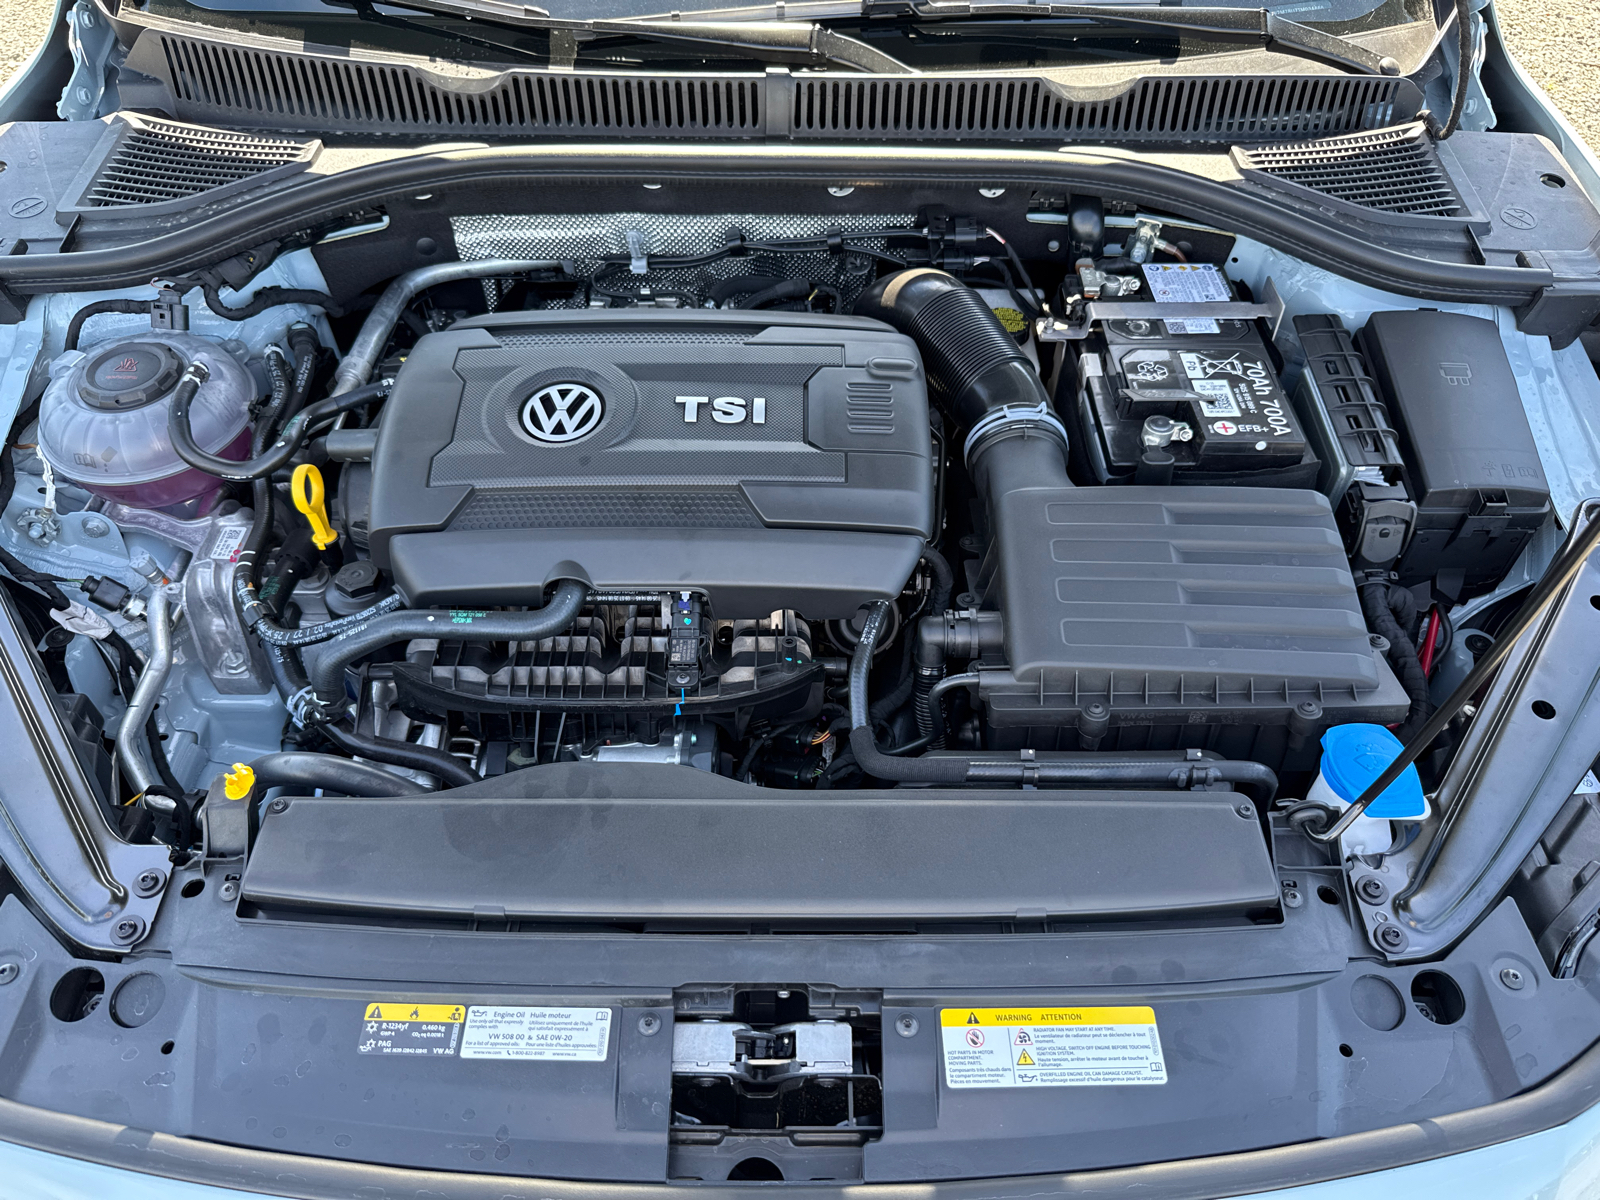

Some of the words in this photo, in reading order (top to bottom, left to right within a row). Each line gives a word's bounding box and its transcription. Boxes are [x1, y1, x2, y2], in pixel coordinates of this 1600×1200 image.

[1186, 360, 1197, 371] Pb
[1243, 361, 1273, 395] 70Ah
[1260, 399, 1291, 436] 700A
[675, 396, 766, 424] TSI
[1238, 424, 1270, 433] EFB+
[494, 1011, 515, 1019] Engine
[995, 1014, 1032, 1022] WARNING
[382, 1023, 409, 1031] R-1234yf
